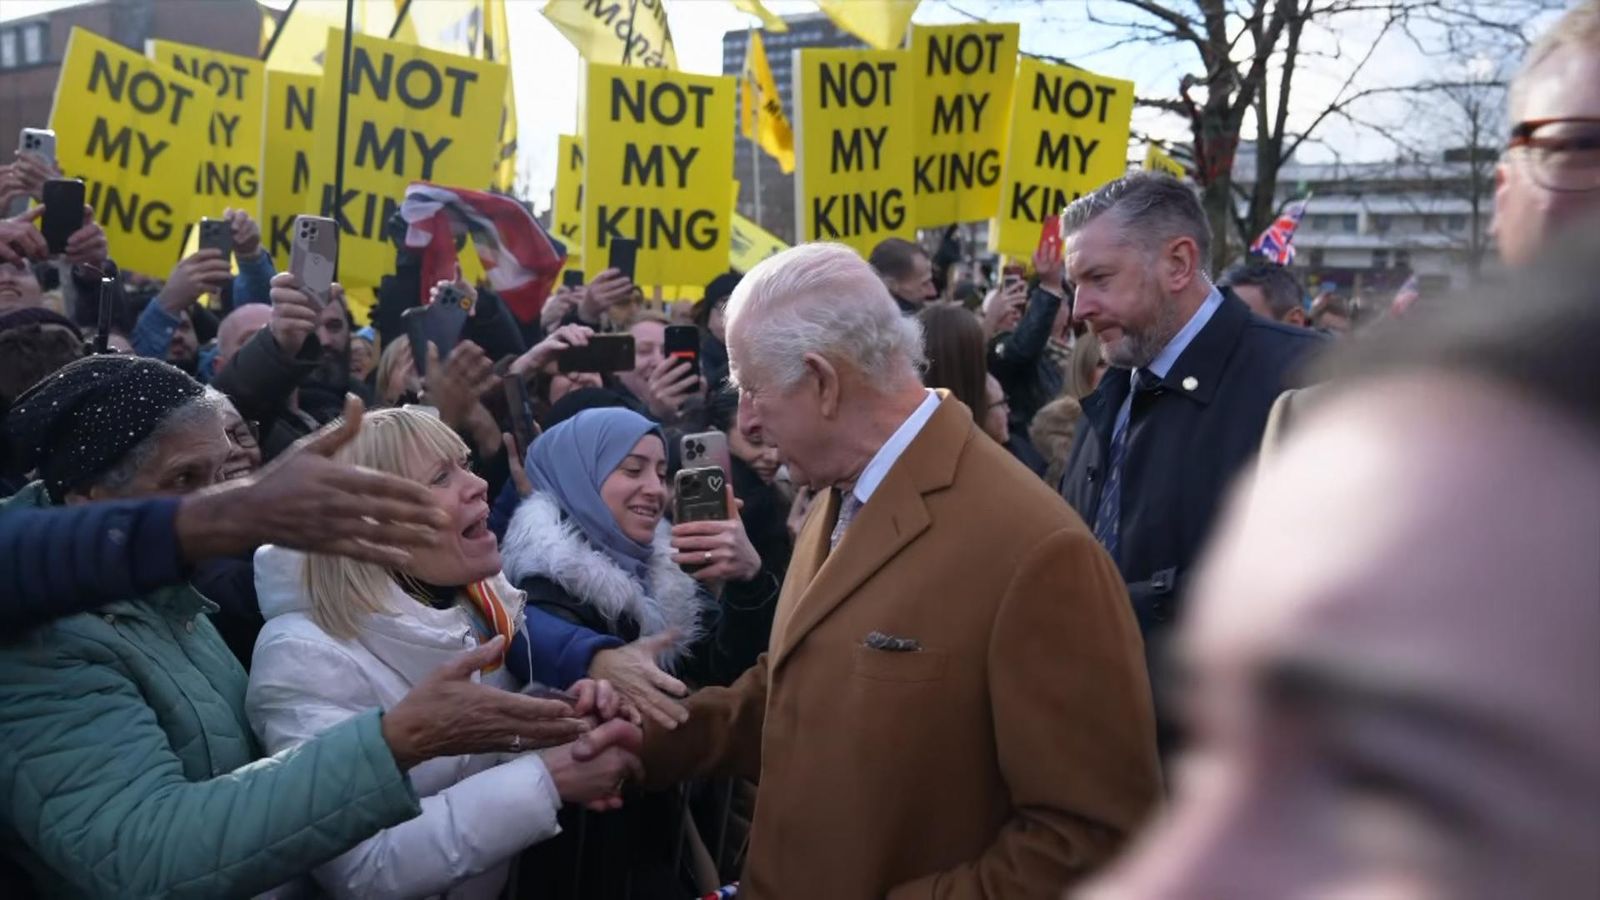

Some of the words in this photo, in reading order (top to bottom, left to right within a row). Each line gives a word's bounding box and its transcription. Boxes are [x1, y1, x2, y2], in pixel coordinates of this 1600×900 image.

[925, 33, 1004, 77] NOT
[87, 49, 195, 126] NOT
[349, 46, 478, 118] NOT
[610, 77, 714, 128] NOT
[819, 61, 897, 108] NOT
[1032, 72, 1117, 123] NOT
[931, 92, 990, 135] MY
[84, 115, 170, 177] MY
[354, 120, 453, 181] MY
[622, 142, 700, 189] MY
[830, 126, 888, 174] MY
[1035, 130, 1099, 175] MY
[195, 160, 259, 199] ING
[913, 148, 1001, 195] KING
[77, 174, 173, 242] ING
[813, 188, 907, 239] KING
[1010, 182, 1081, 223] KIN
[597, 205, 719, 251] KING
